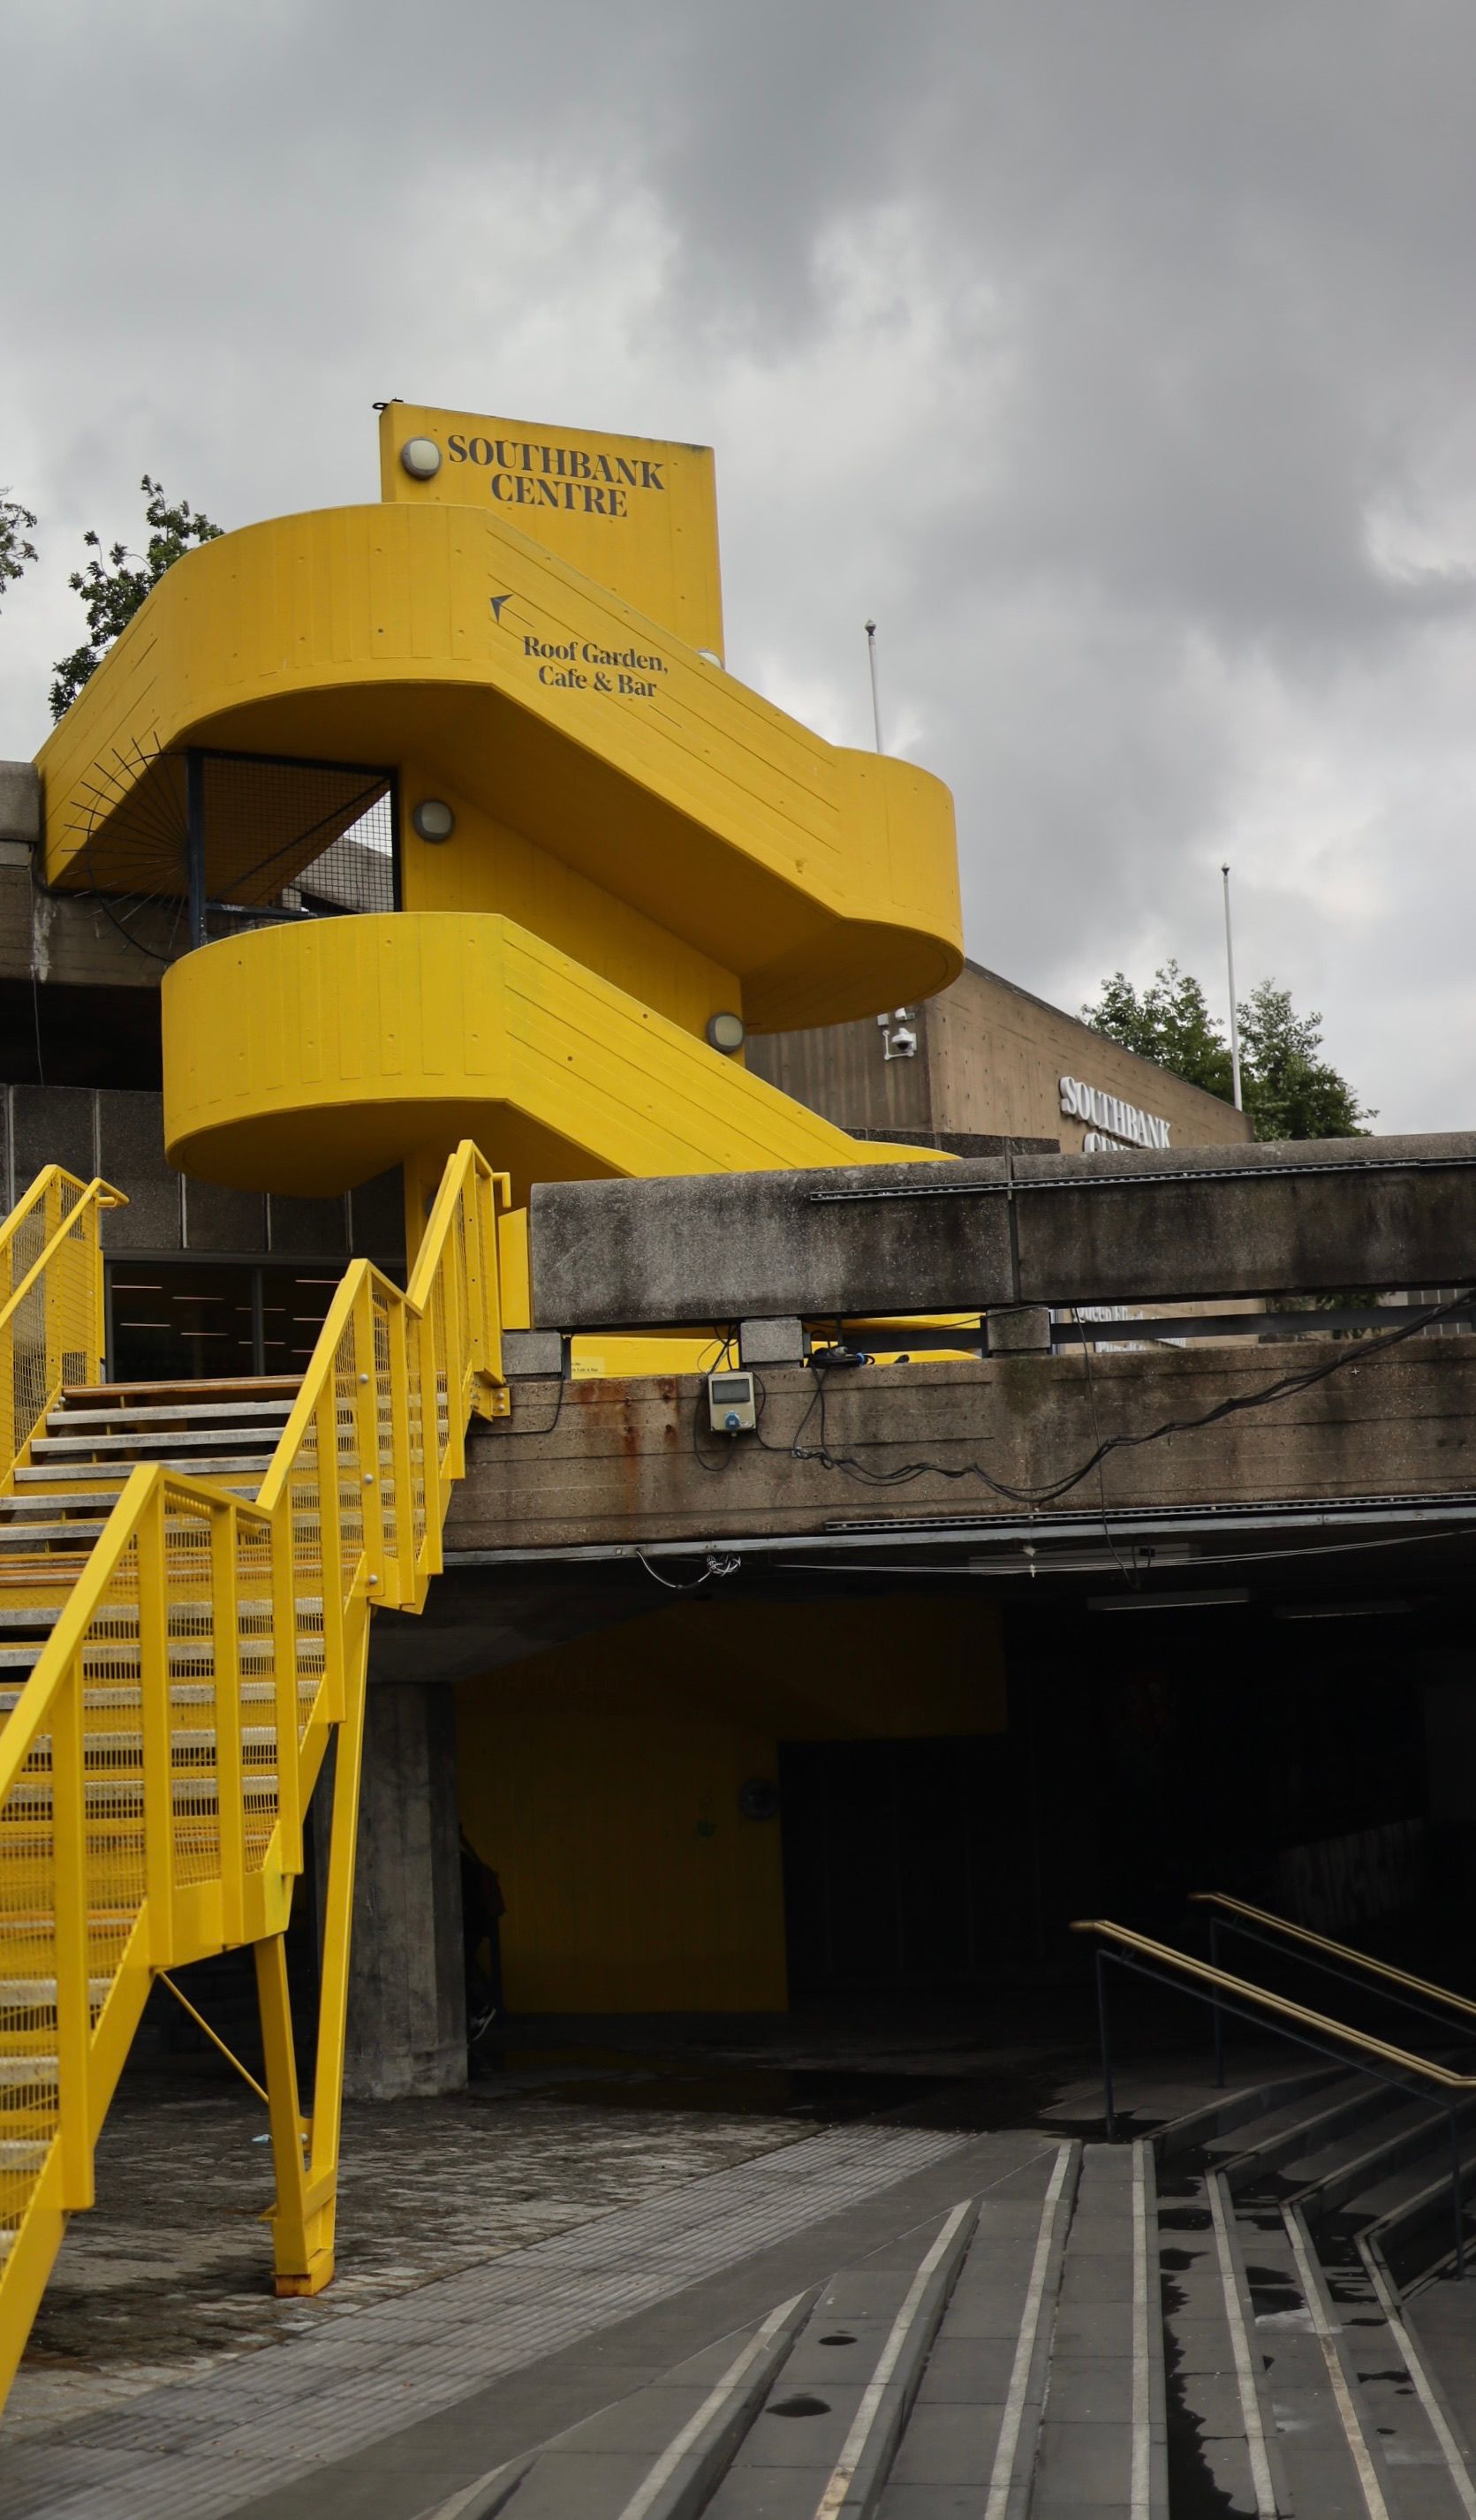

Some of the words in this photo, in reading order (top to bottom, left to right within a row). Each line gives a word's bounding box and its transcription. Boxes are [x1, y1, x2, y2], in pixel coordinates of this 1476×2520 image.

[448, 435, 664, 489] SOUTHBANK
[491, 473, 628, 518] CENTRE
[523, 635, 578, 661] Roof
[581, 643, 668, 674] Garden,
[538, 665, 587, 690] Cafe
[594, 671, 613, 692] &
[617, 674, 657, 698] Bar
[1060, 1076, 1170, 1149] SOUTHBANK
